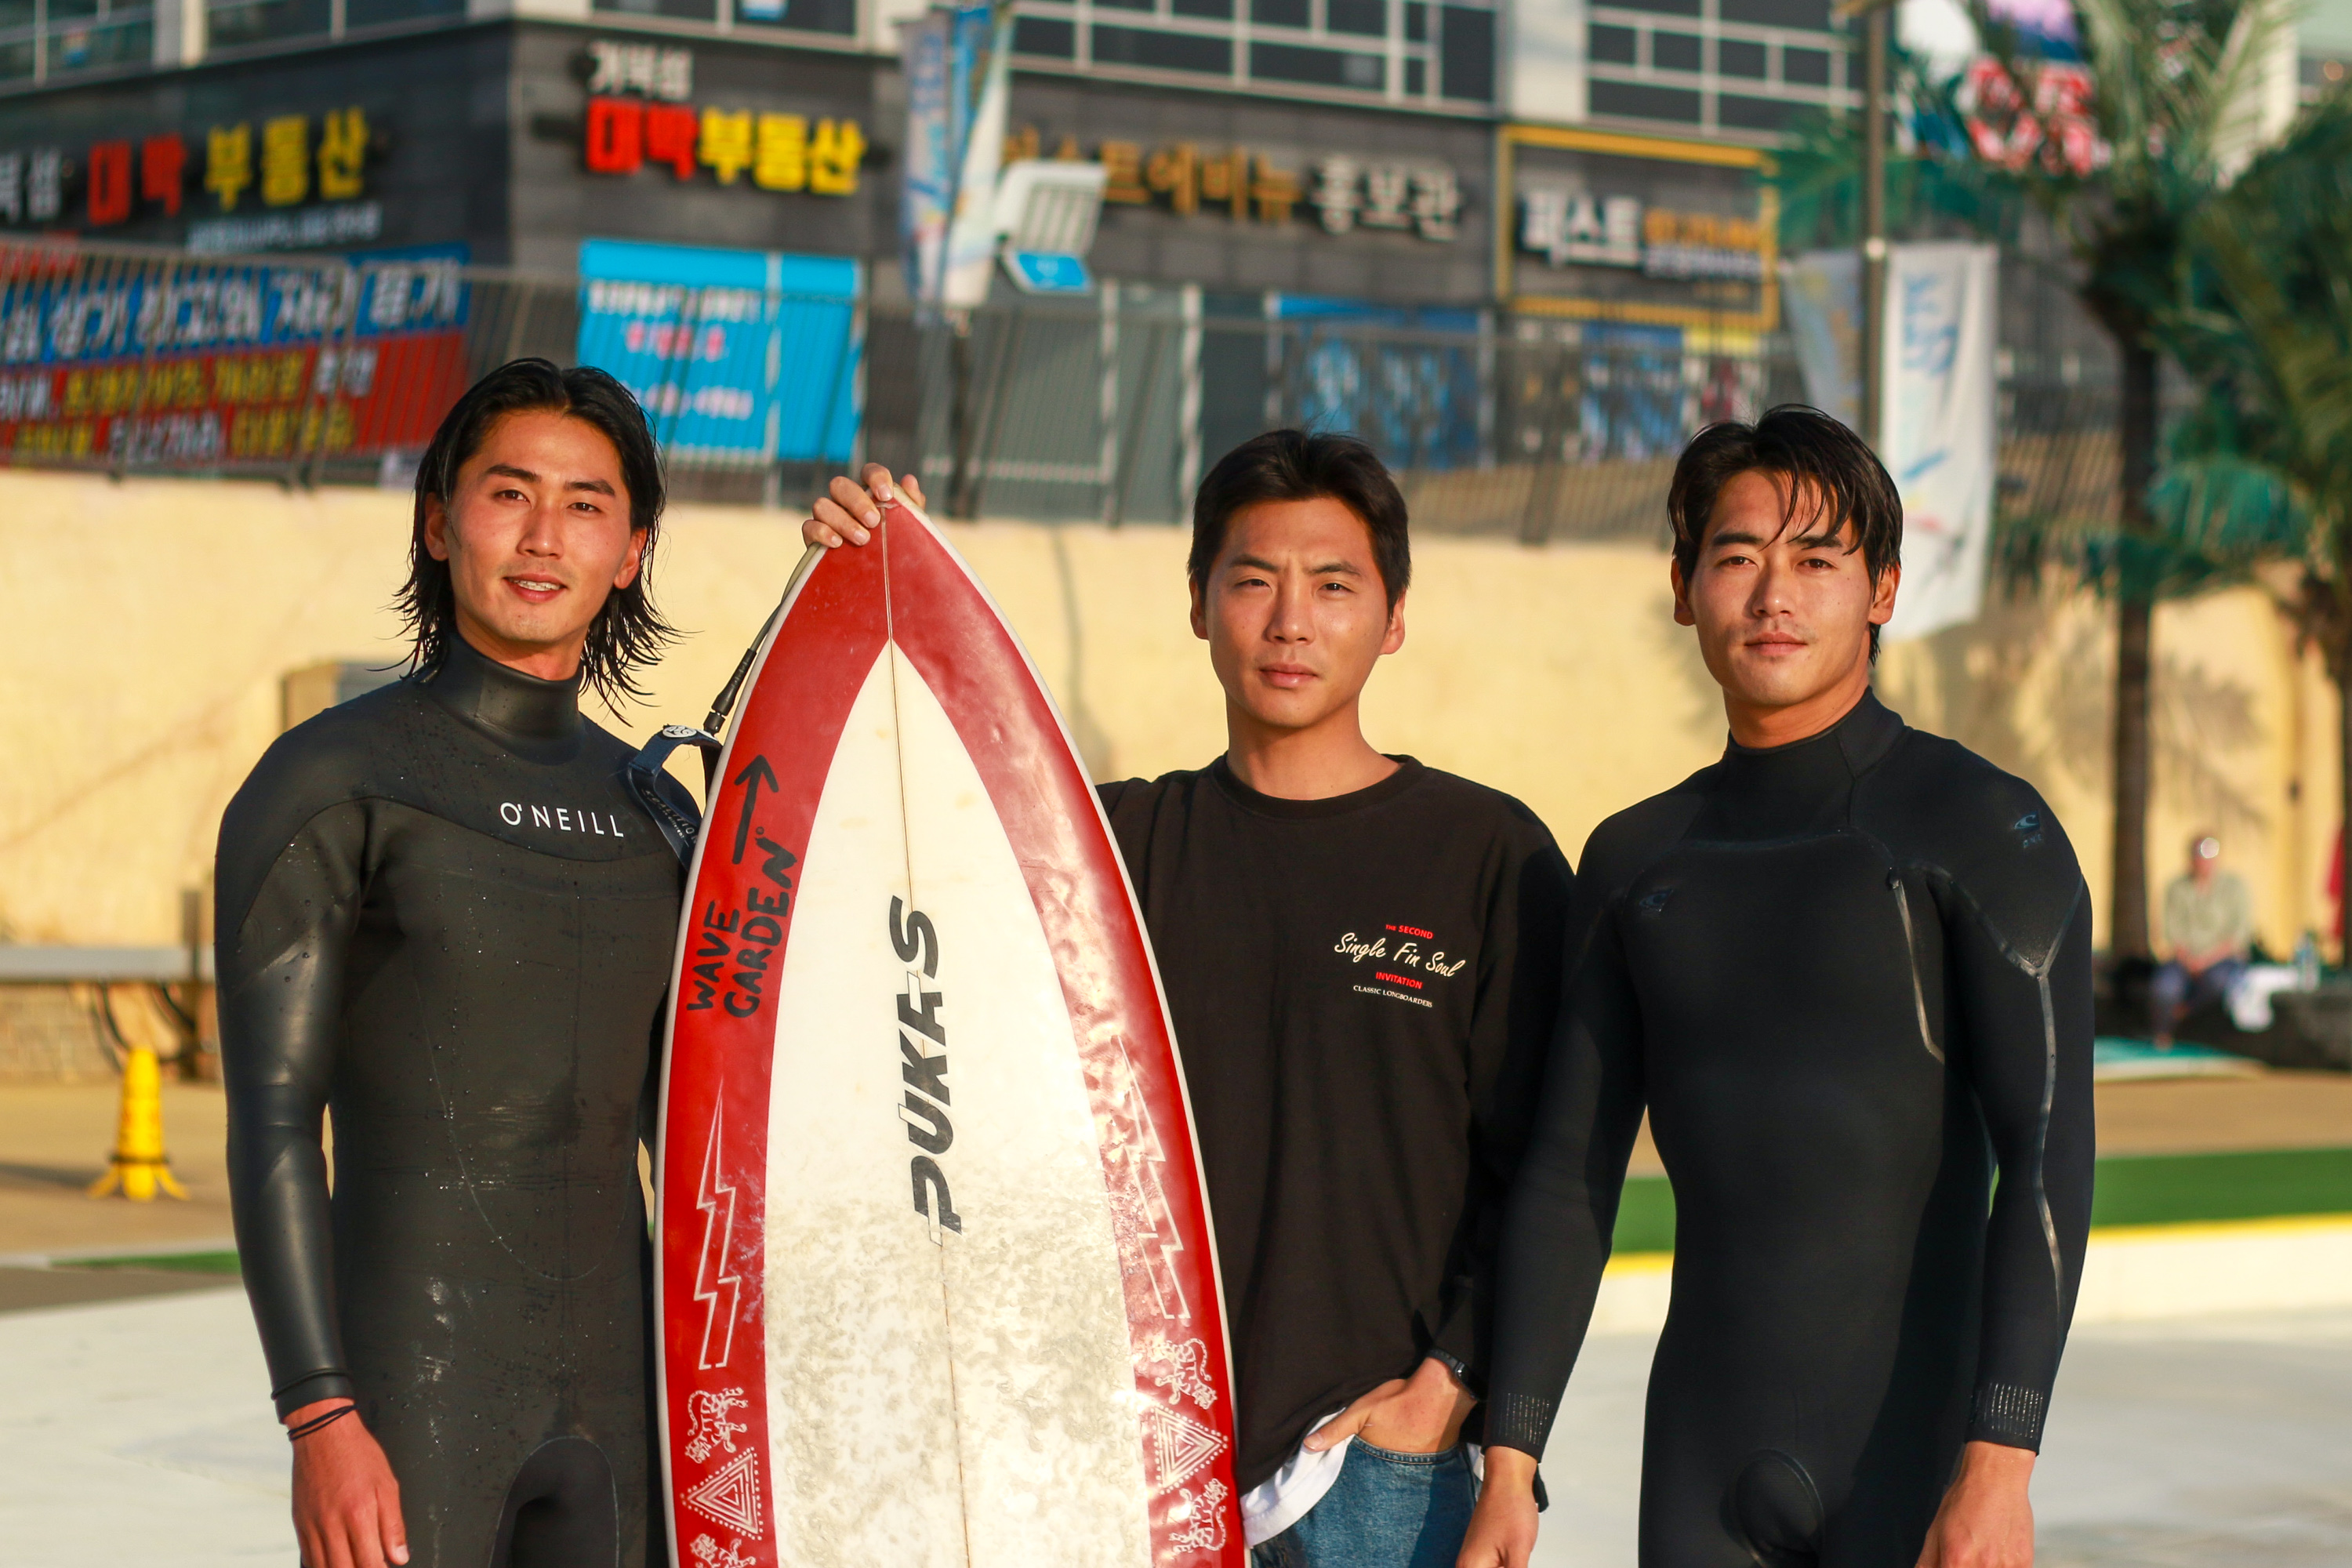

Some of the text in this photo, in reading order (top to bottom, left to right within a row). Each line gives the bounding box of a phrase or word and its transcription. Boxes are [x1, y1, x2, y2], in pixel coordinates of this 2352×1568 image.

[590, 39, 694, 100] 거북섬
[206, 107, 368, 211] 부동산
[500, 801, 624, 837] O'NEILL
[1334, 932, 1466, 978] Single Fin Soul
[1398, 925, 1434, 939] SECOND
[687, 900, 740, 1011] WAVE
[1352, 985, 1433, 1008] CLASSIC LONGBOARDERS
[1375, 971, 1424, 989] INVITATION
[888, 895, 963, 1247] PUKAS
